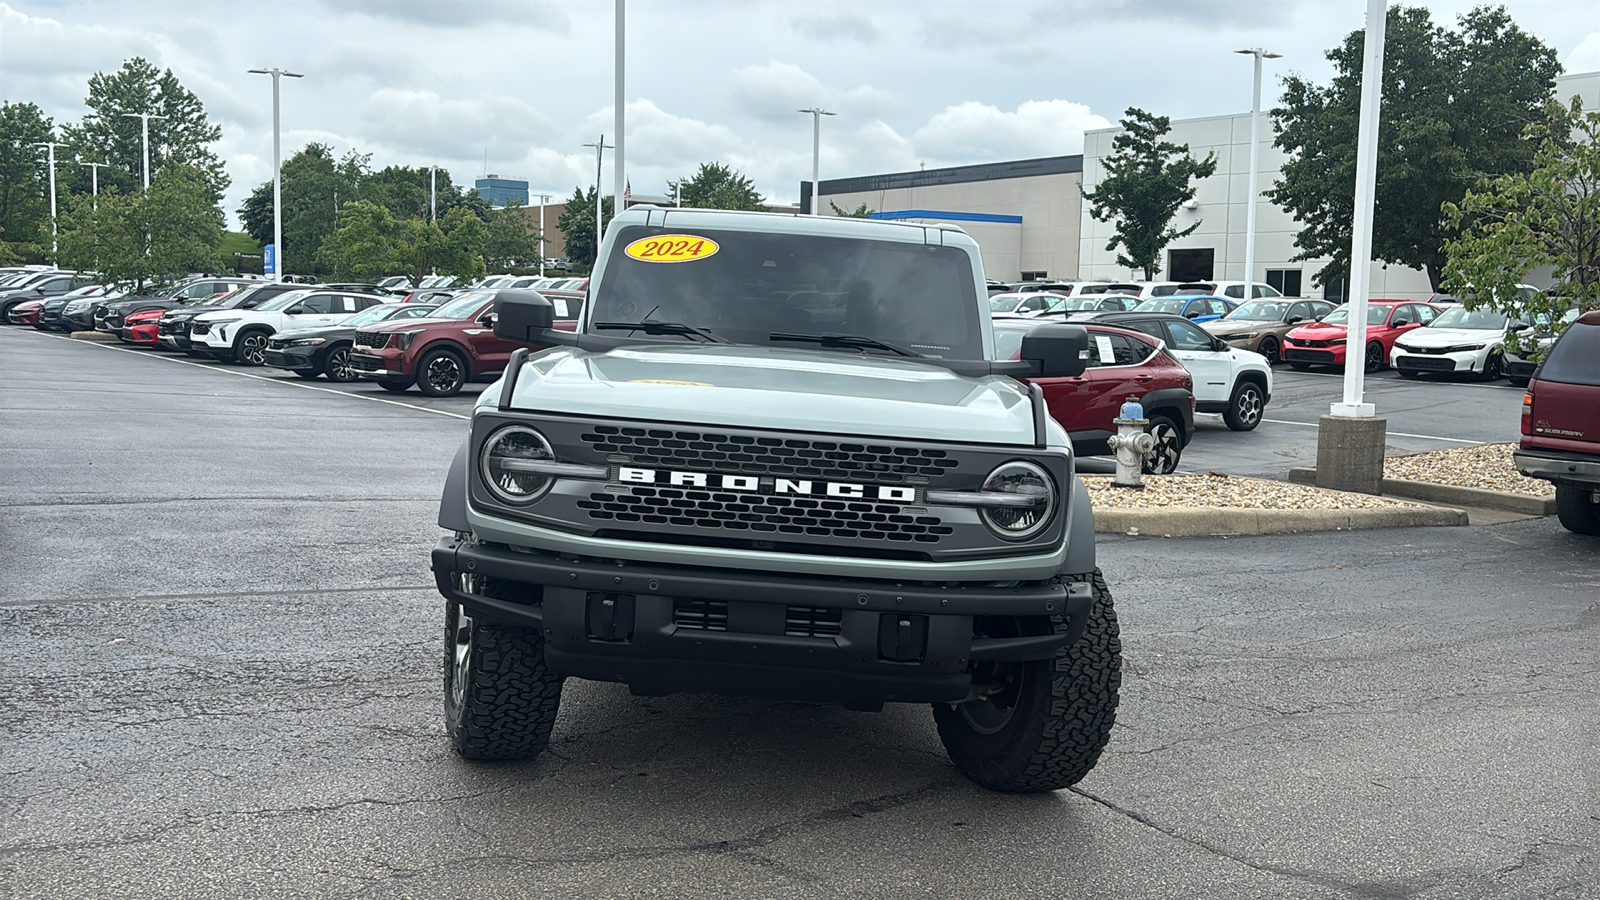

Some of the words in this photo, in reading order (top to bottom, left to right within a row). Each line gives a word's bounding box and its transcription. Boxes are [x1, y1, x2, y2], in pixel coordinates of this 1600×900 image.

[640, 241, 704, 257] 2024
[1544, 428, 1584, 437] SUBURBAN
[618, 466, 916, 502] BRONCO
